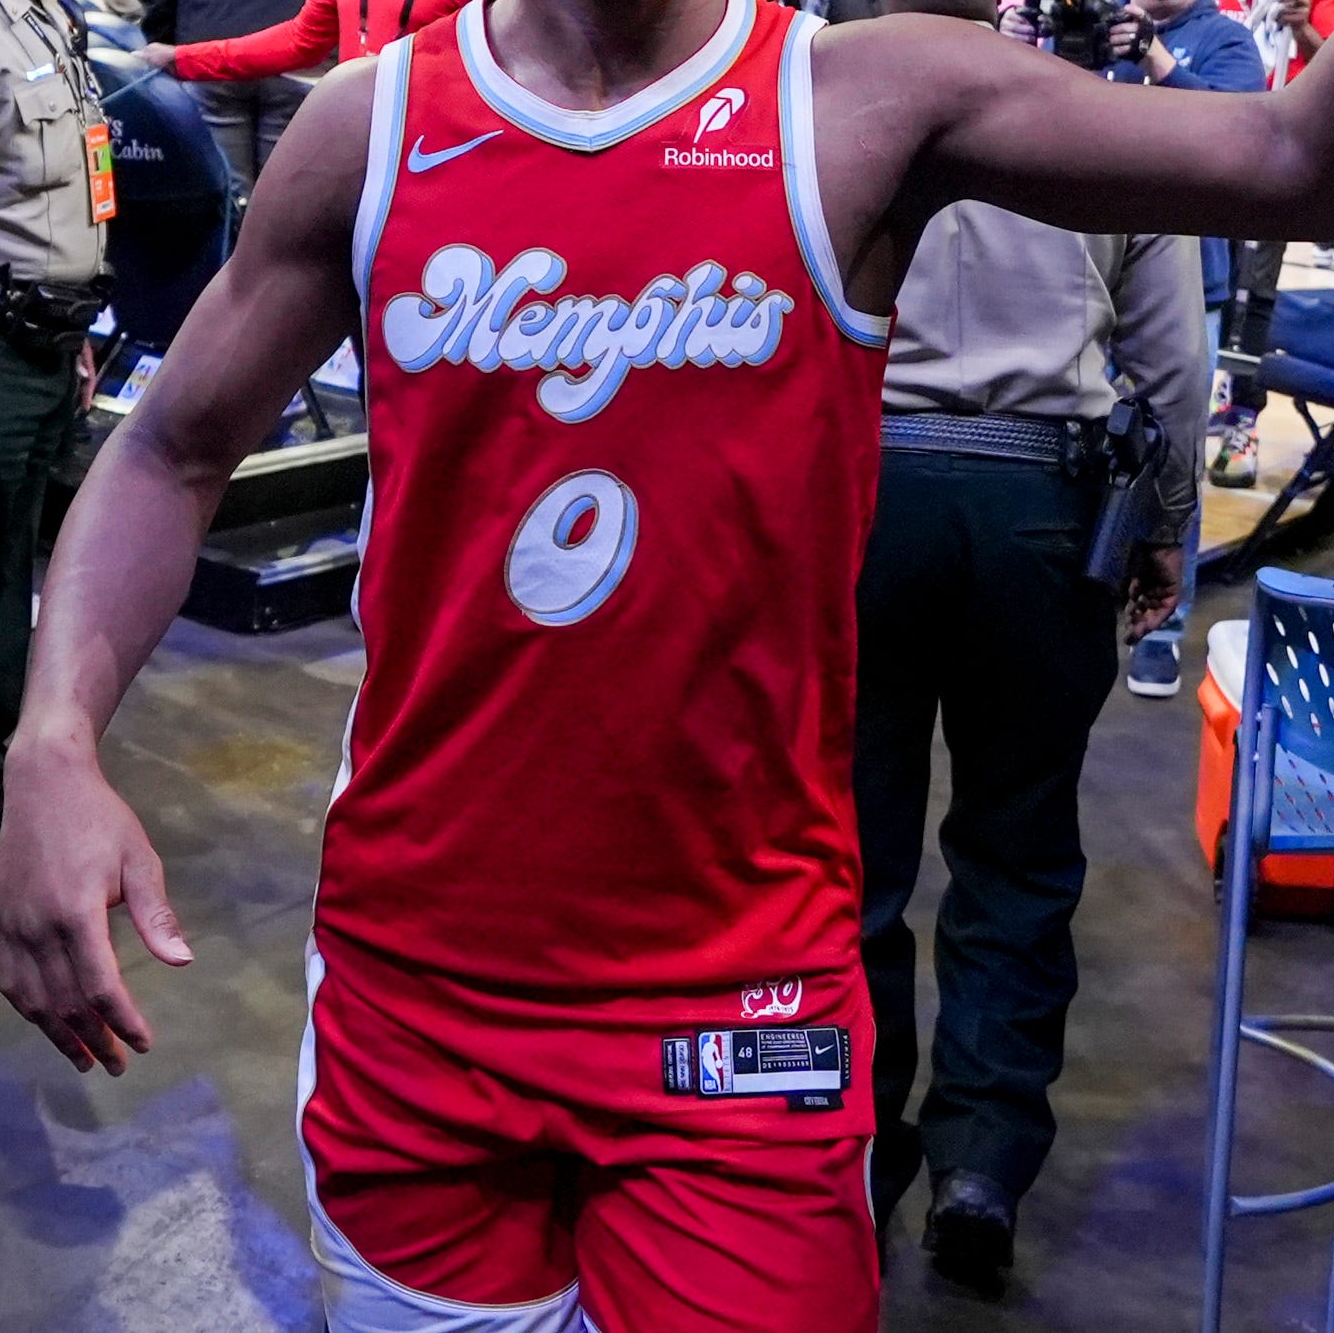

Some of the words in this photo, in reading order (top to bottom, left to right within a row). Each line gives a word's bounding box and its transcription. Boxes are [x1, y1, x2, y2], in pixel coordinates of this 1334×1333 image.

[664, 147, 774, 168] Robinhood
[382, 242, 795, 424] Memphis
[503, 468, 640, 627] 0
[760, 1032, 805, 1041] ENGINEERED
[738, 1046, 753, 1059] 48
